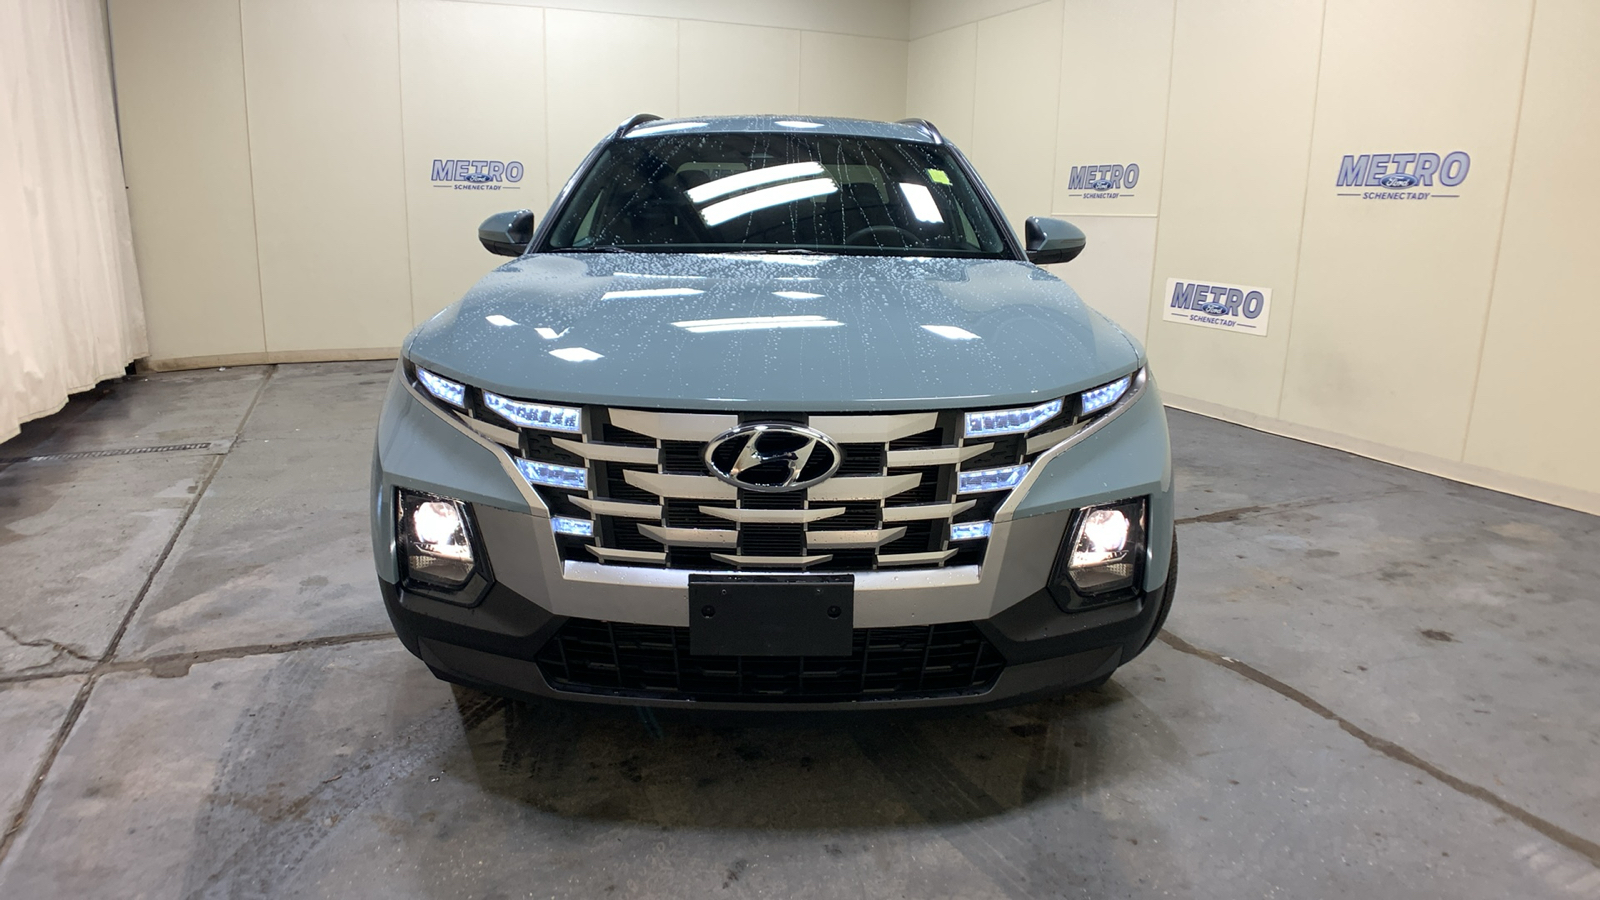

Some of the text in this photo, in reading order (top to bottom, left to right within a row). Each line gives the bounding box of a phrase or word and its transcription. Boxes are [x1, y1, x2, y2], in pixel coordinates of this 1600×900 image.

[431, 159, 524, 183] METRO
[1068, 163, 1140, 190] METRO
[1336, 151, 1471, 187] METRO
[1385, 176, 1411, 187] Ford
[1362, 192, 1431, 200] SCHENECTADY
[1170, 282, 1265, 319] METRO
[1189, 314, 1237, 327] SCHENECTADY
